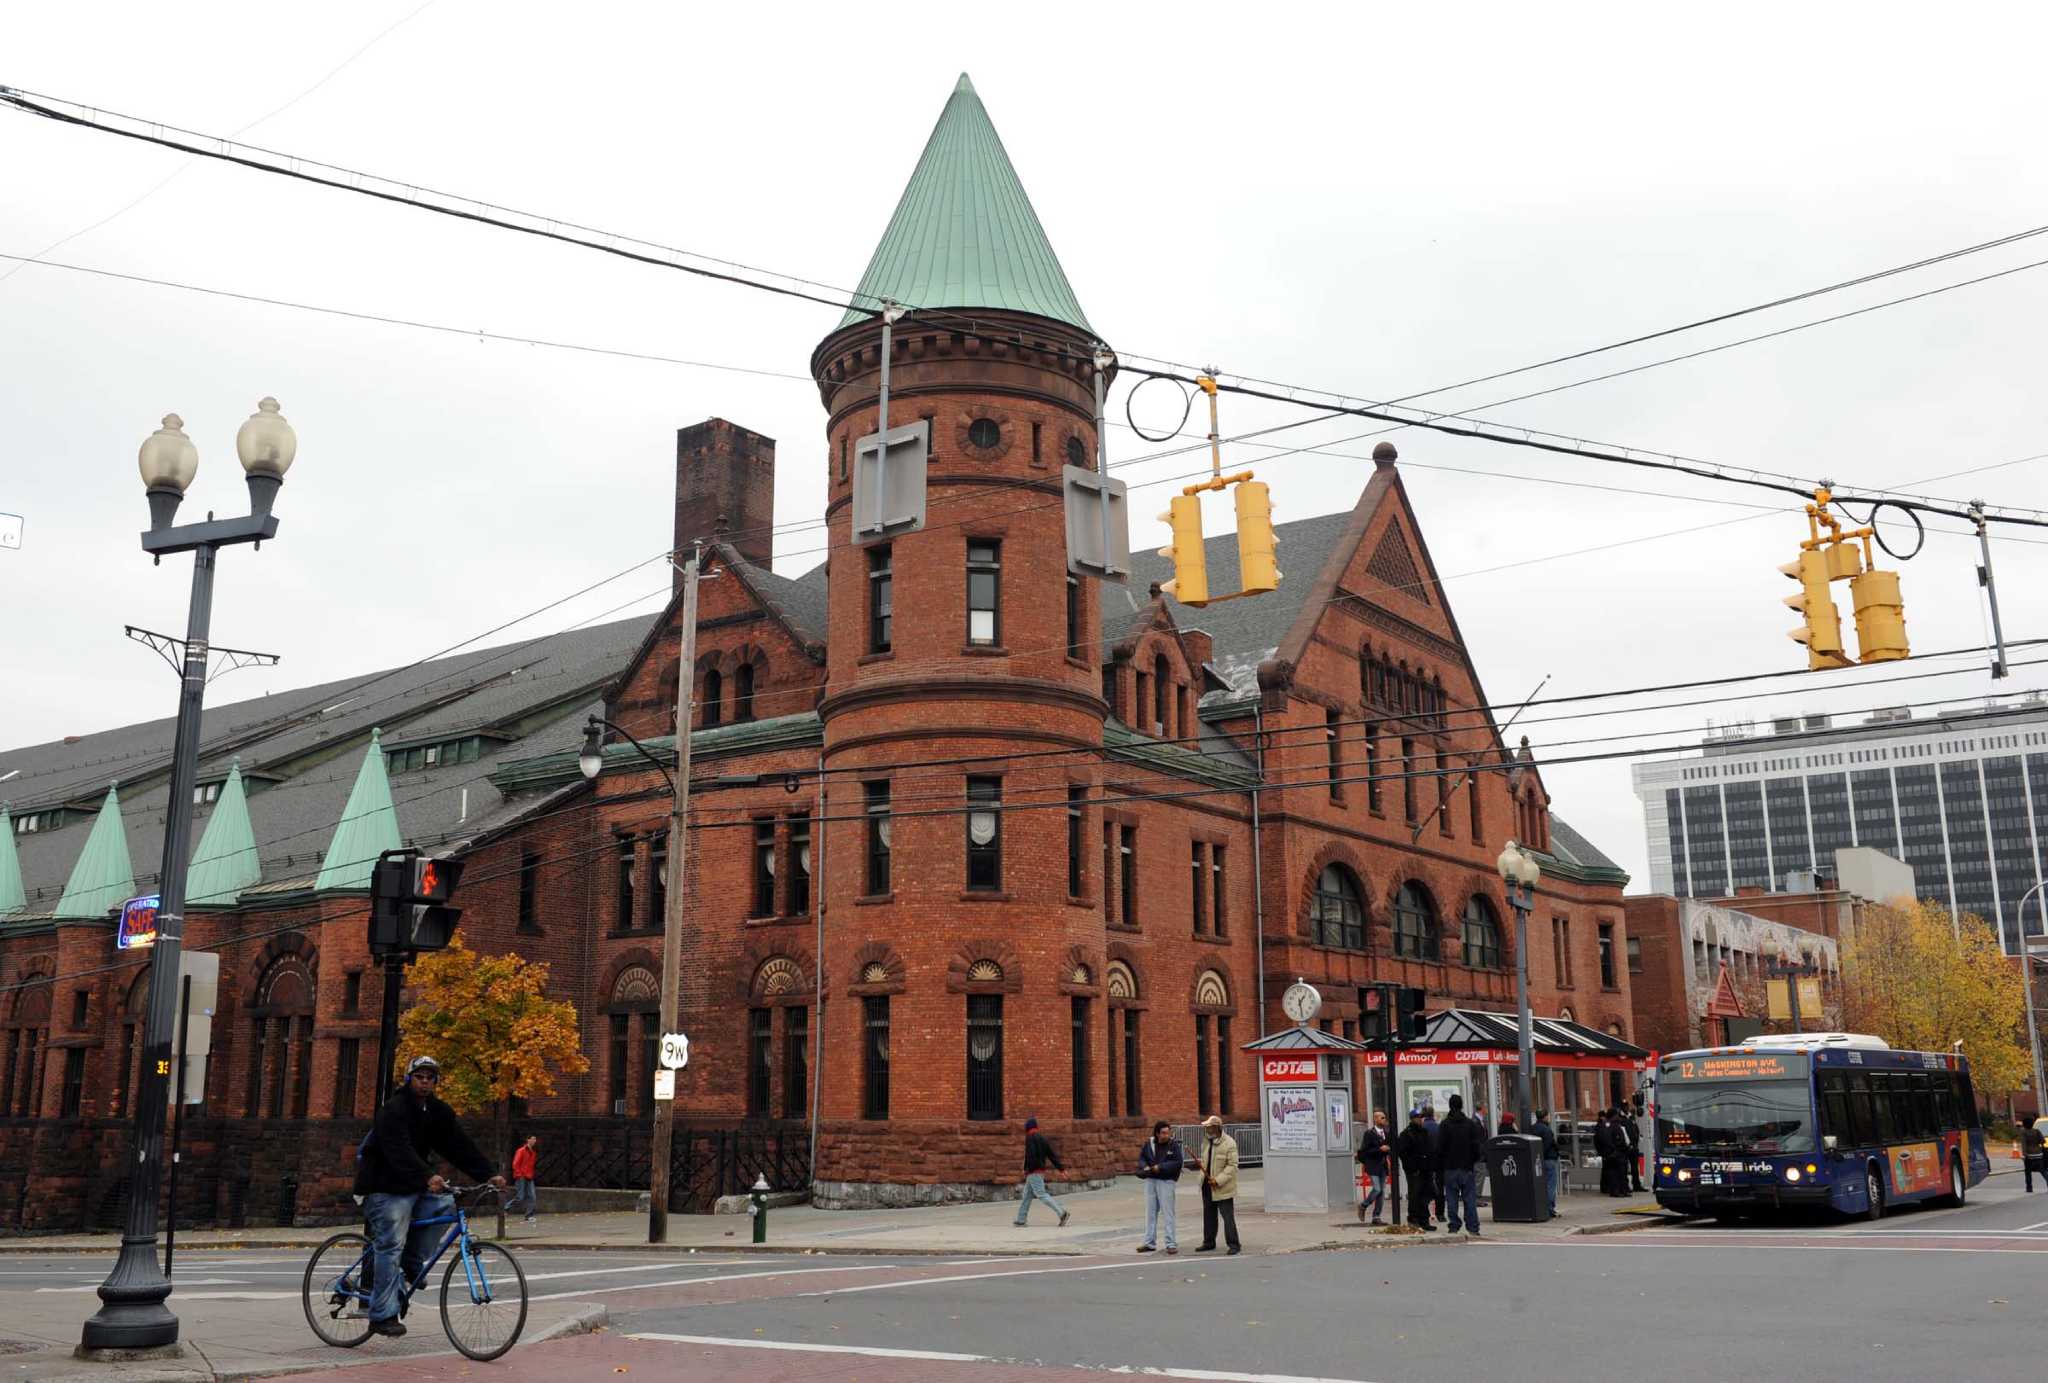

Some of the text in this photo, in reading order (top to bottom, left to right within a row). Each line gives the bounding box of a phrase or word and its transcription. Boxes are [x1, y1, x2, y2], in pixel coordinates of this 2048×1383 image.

[665, 1041, 686, 1061] 9W
[1398, 1052, 1438, 1064] Armory
[1265, 1061, 1316, 1075] CDTA
[1682, 1062, 1695, 1078] 12
